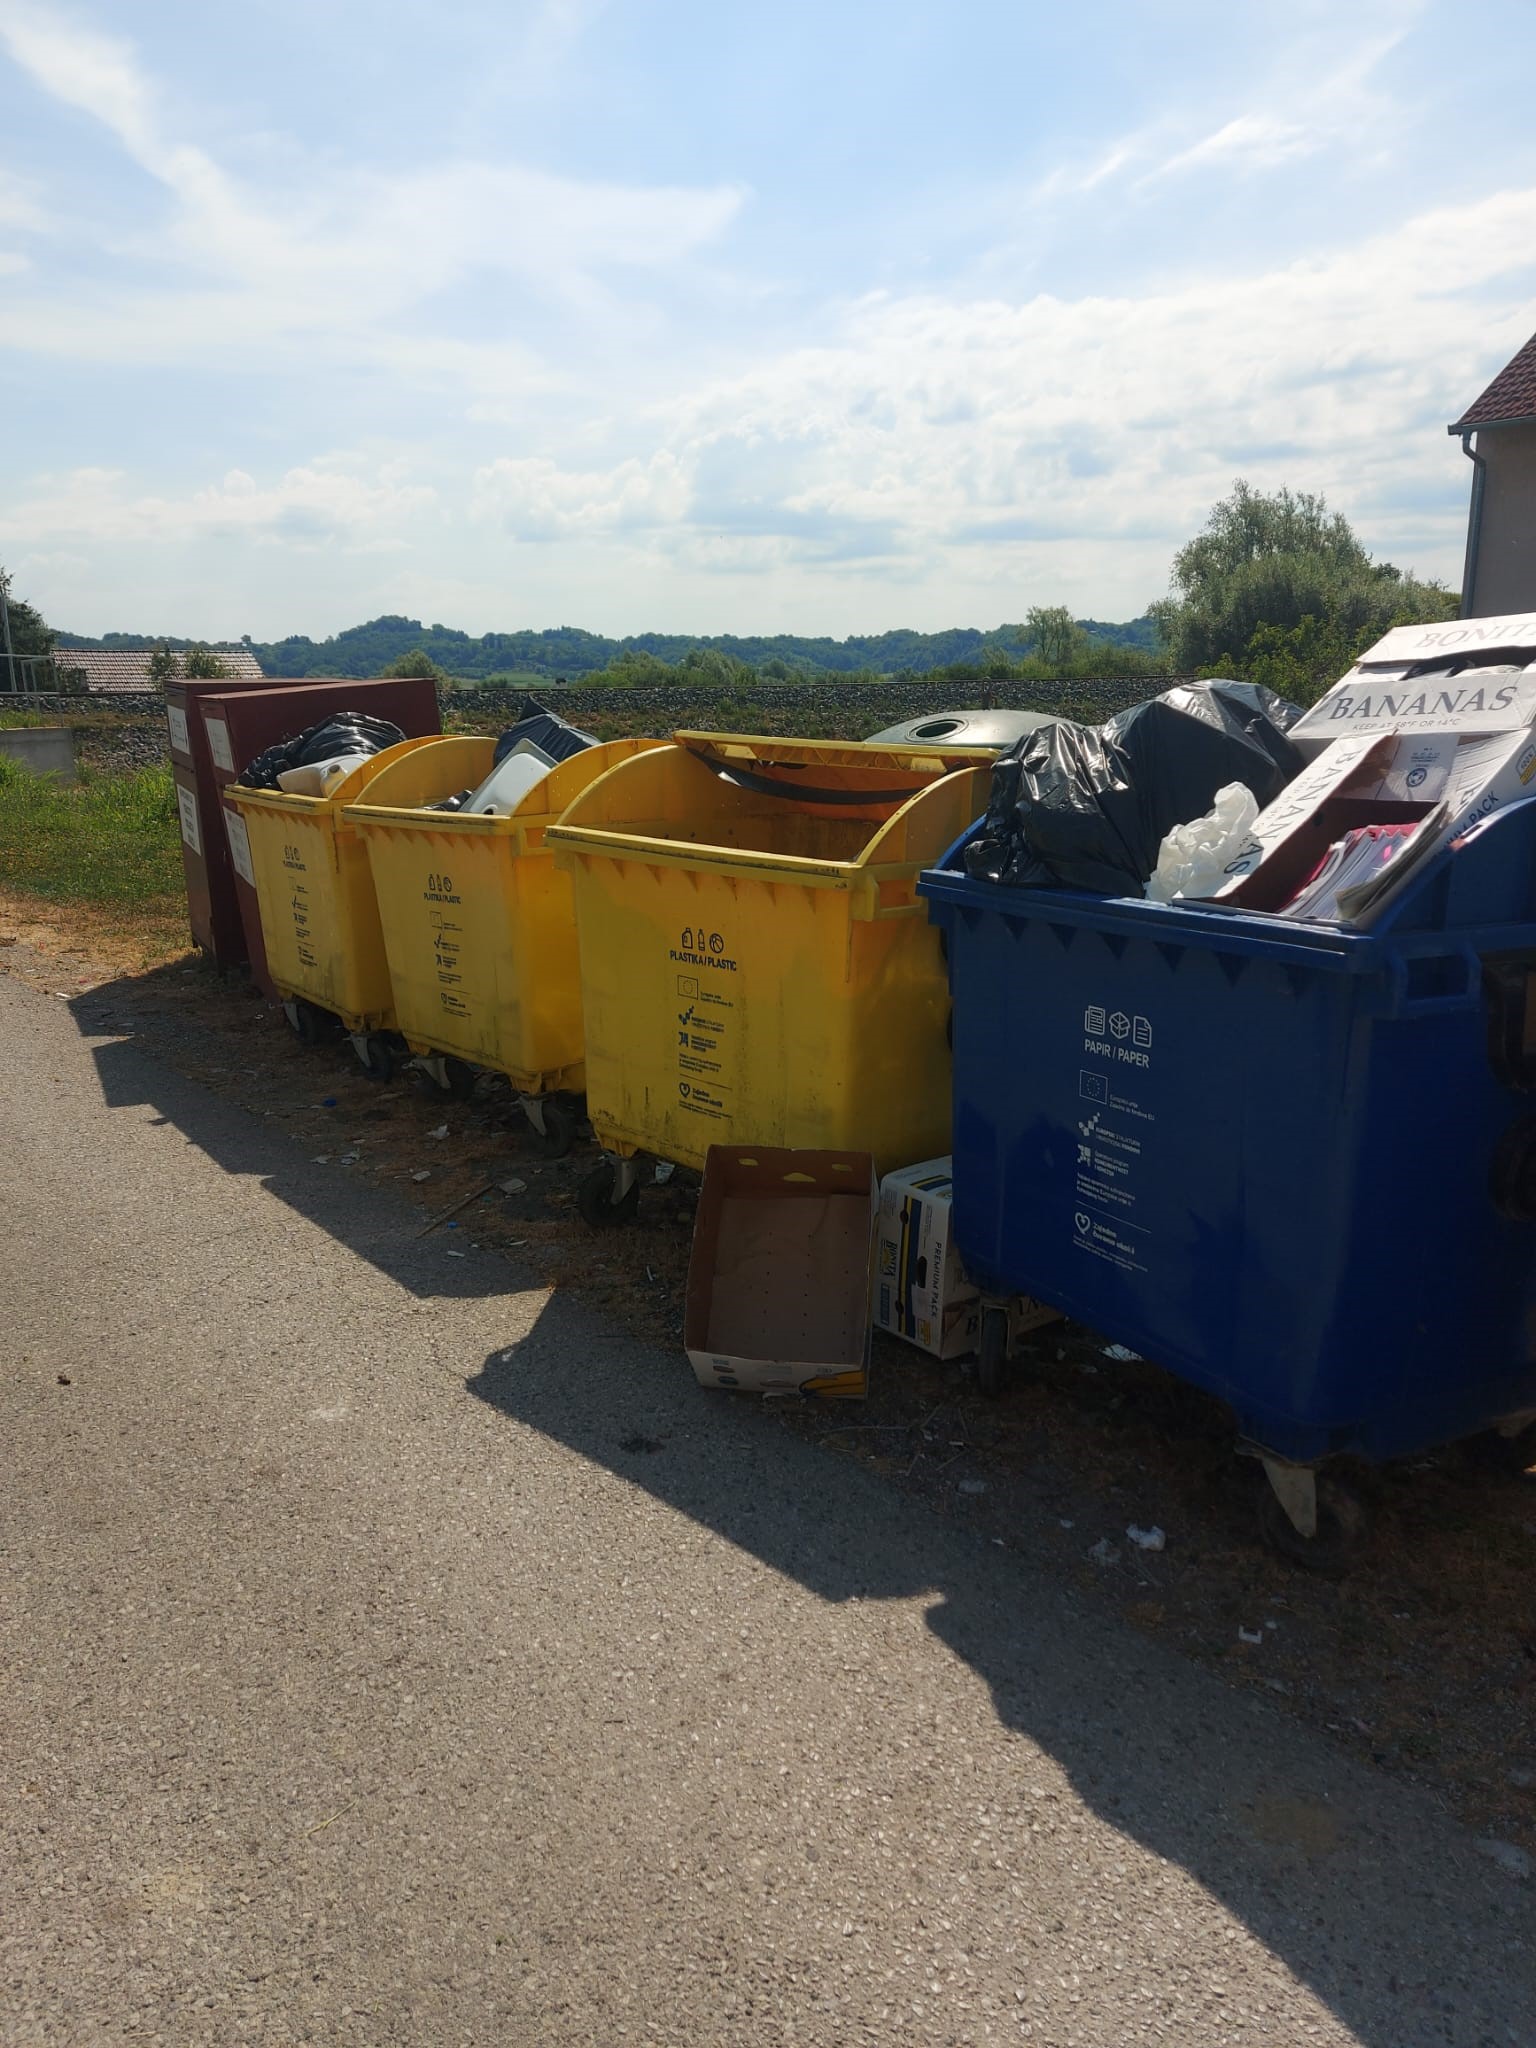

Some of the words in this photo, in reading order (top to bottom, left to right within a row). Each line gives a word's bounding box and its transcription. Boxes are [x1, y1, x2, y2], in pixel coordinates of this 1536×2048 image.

[1328, 686, 1518, 720] BANANAS
[1353, 721, 1377, 731] KEEP
[1419, 720, 1433, 728] OR
[1468, 790, 1499, 824] PACK
[669, 950, 704, 966] PLASTIKA
[708, 957, 737, 972] PLASTIC
[1084, 1038, 1111, 1058] PAPIR
[1118, 1048, 1150, 1068] PAPER
[932, 1242, 943, 1289] PREMIUM
[931, 1290, 939, 1318] PACK
